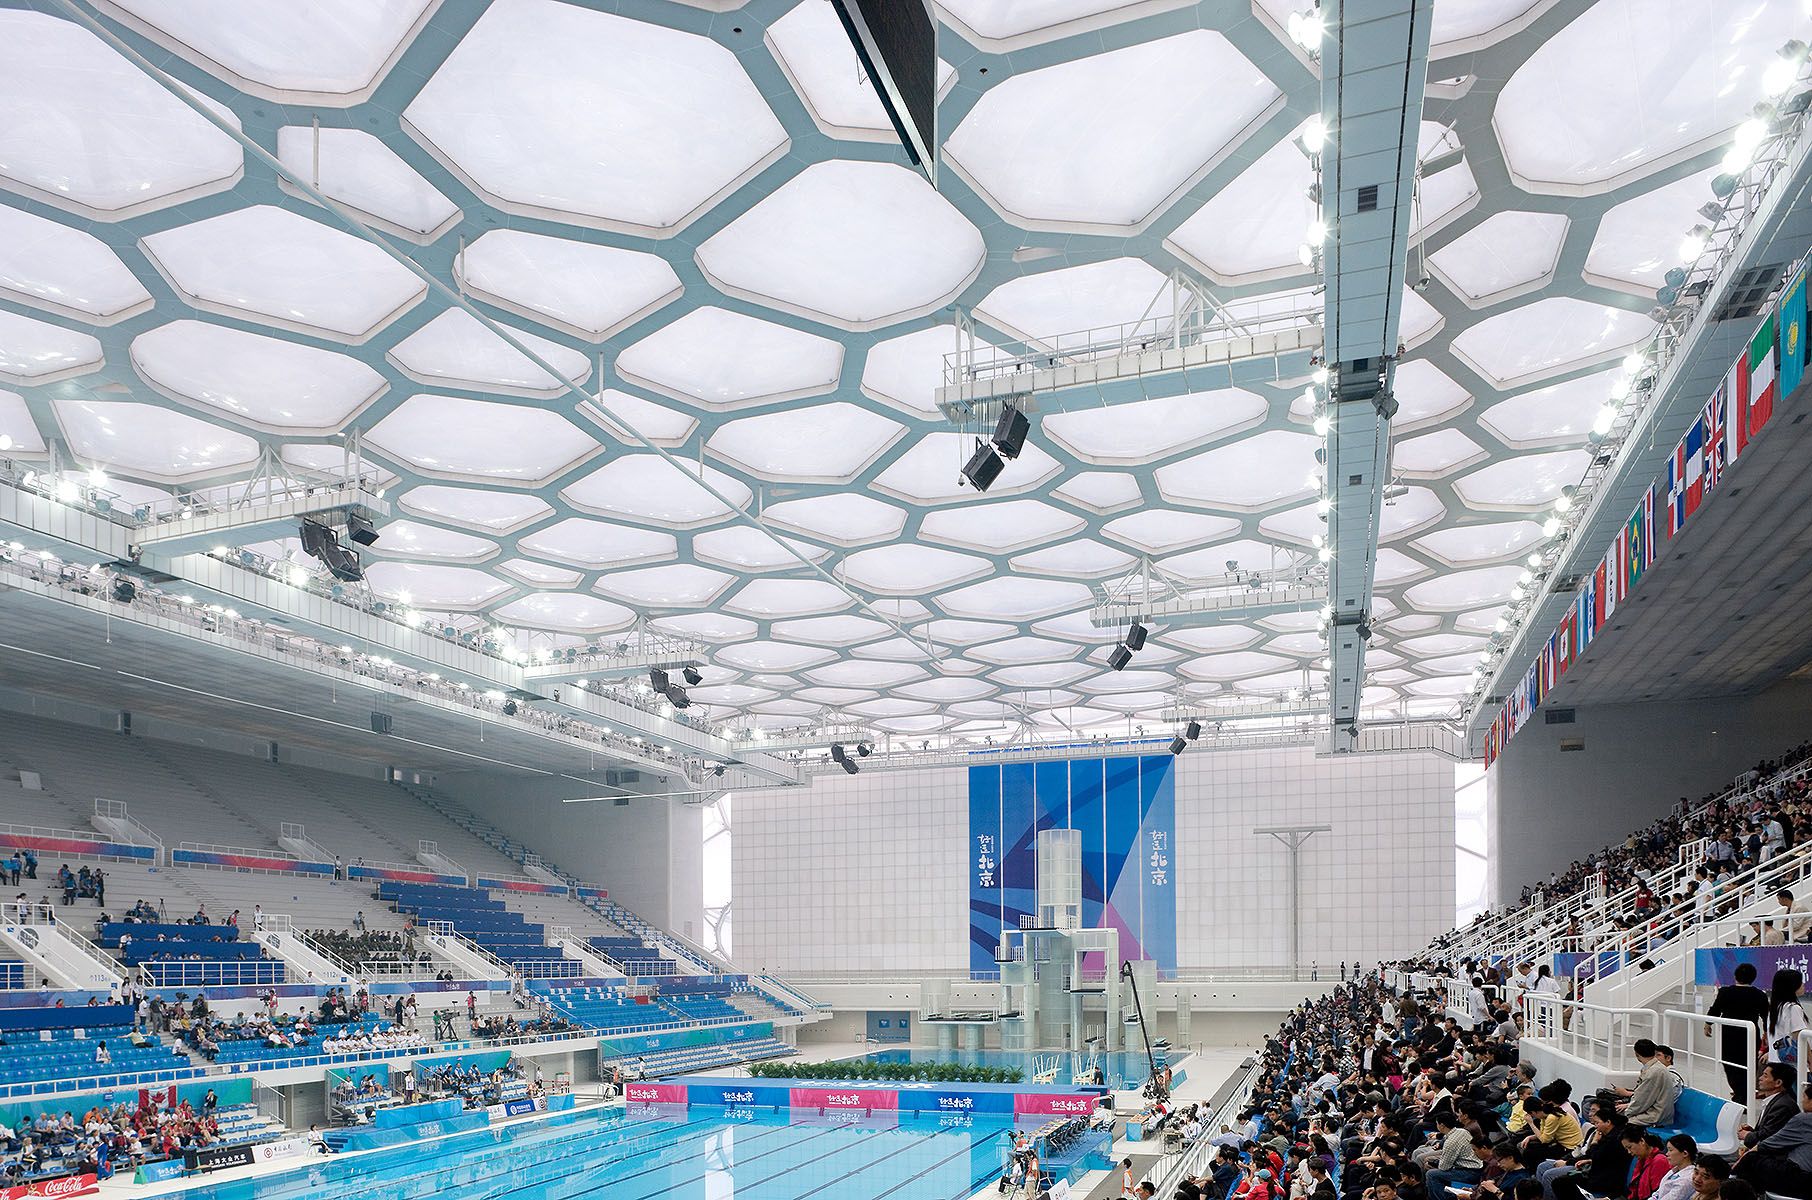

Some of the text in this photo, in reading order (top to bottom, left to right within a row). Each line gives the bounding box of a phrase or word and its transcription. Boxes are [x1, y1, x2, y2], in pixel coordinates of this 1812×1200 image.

[977, 833, 995, 888] 好运北京
[1149, 829, 1168, 886] 好运北京
[628, 1088, 659, 1099] 好运北京
[723, 1090, 754, 1102] 好运北京
[826, 1093, 860, 1105] 好运北京
[938, 1095, 973, 1109] 好运北京
[1050, 1099, 1087, 1111] 好运北京
